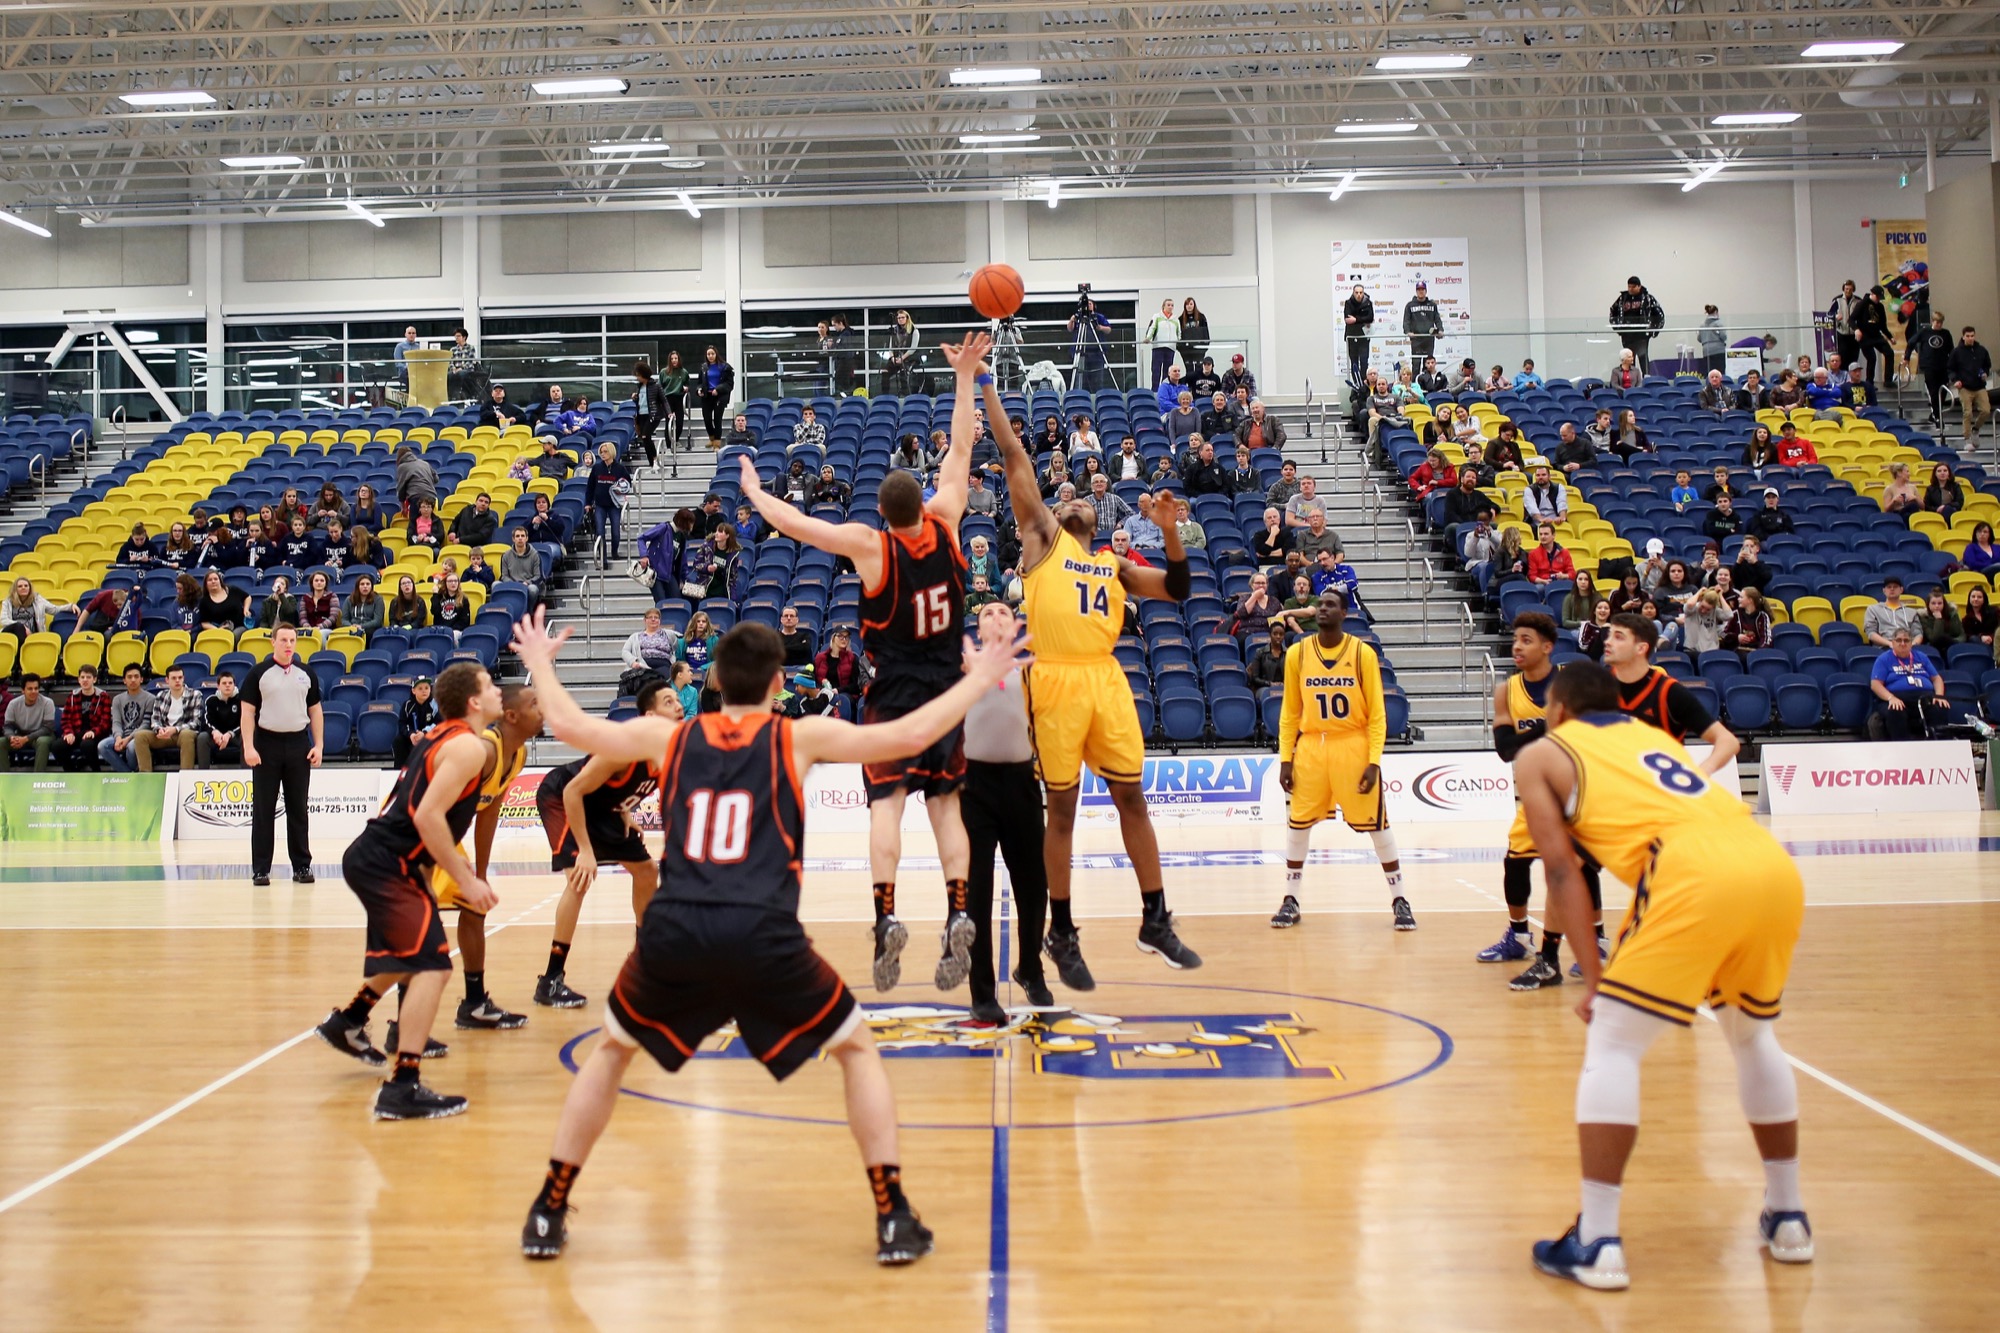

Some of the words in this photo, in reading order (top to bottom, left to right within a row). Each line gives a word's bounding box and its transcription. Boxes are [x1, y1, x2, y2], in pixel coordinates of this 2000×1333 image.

[1885, 232, 1911, 244] PICK
[1075, 581, 1109, 617] 14
[912, 582, 950, 639] 15
[1305, 677, 1354, 688] BOBCATS
[1315, 693, 1350, 720] 10
[1641, 751, 1708, 796] 8
[1811, 768, 1926, 787] VICTORIA
[1927, 767, 1971, 785] INN
[1445, 778, 1509, 791] CANDO
[1167, 793, 1202, 803] Centre
[306, 804, 367, 813] 204-725-1313
[684, 788, 753, 864] 10
